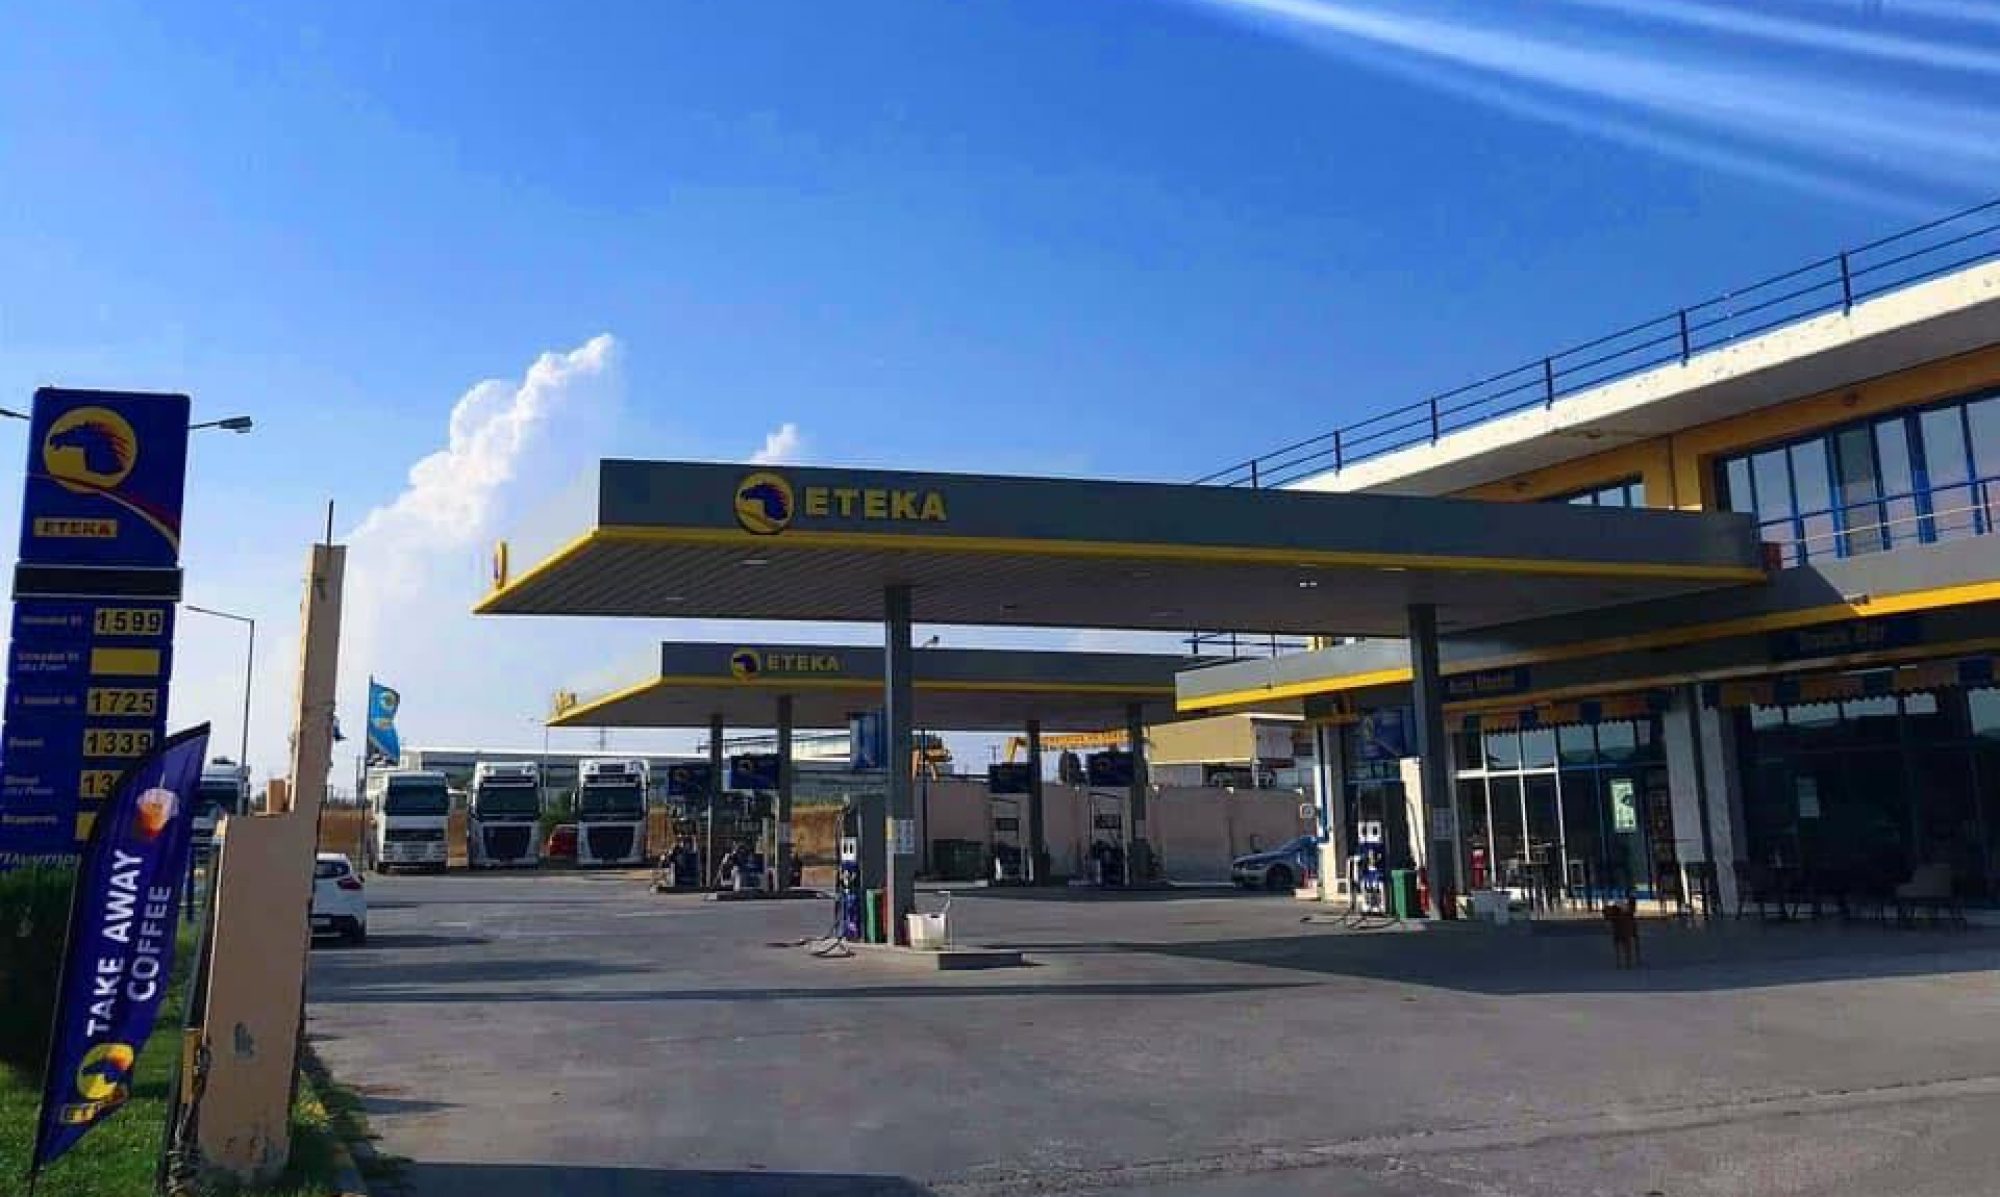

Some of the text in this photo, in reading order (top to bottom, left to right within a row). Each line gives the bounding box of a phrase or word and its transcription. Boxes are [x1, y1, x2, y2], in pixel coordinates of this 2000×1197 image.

[805, 486, 948, 522] ETEKA
[97, 612, 160, 631] 1599
[767, 653, 841, 671] ETEKA
[91, 691, 153, 712] 1725
[87, 732, 151, 753] 1339
[86, 849, 143, 1037] TAKE AWAY
[127, 886, 171, 1002] COFFEE
